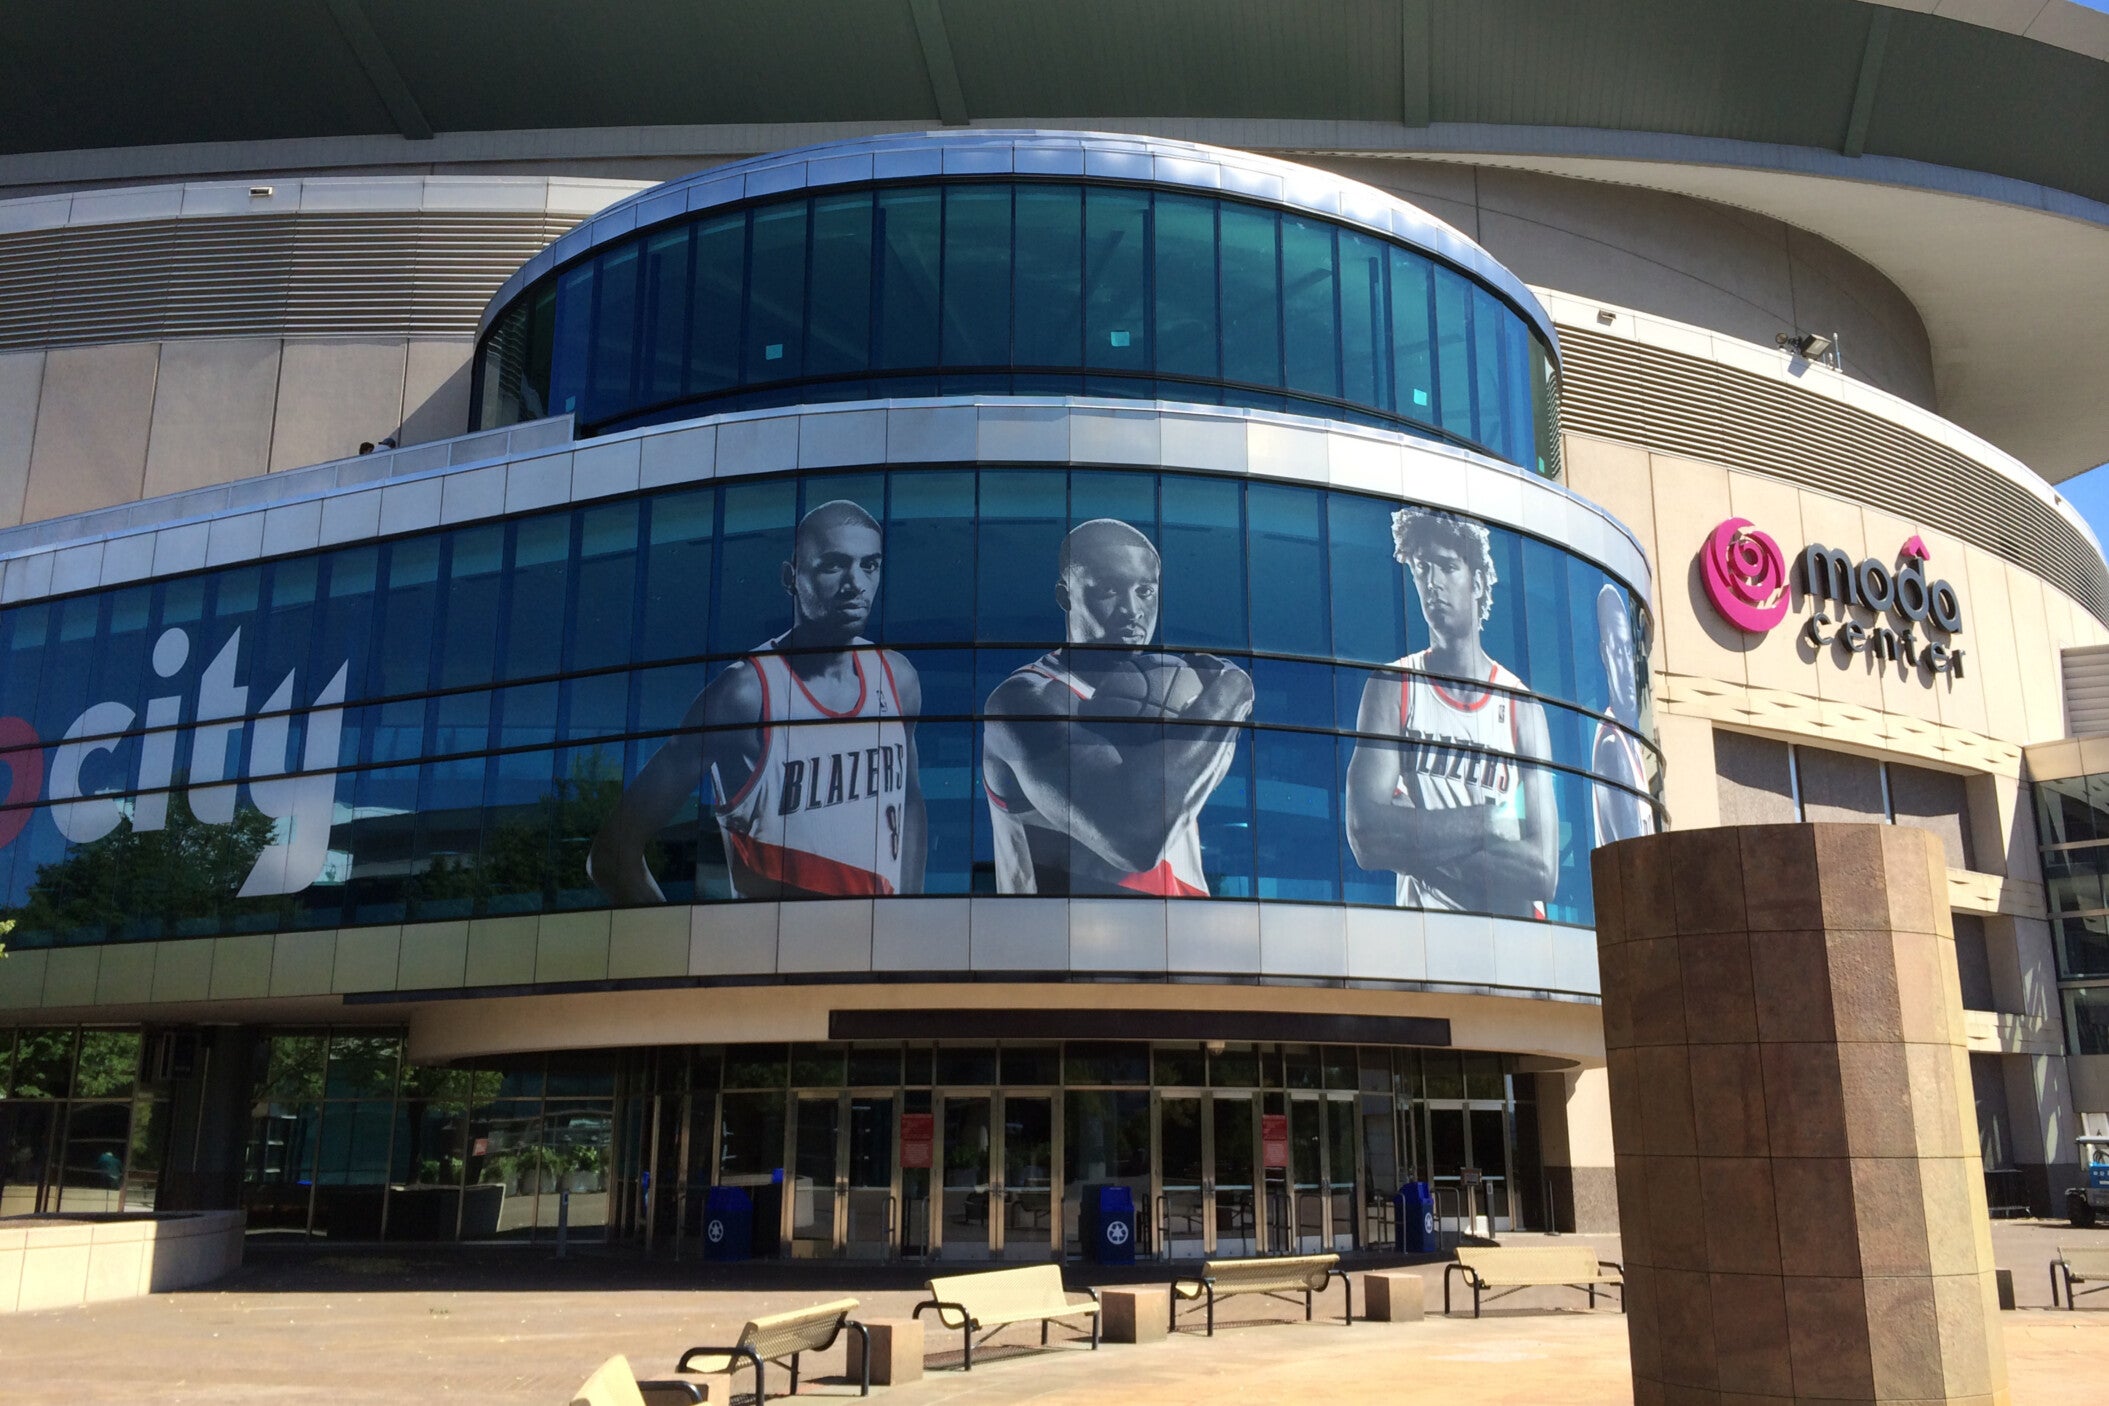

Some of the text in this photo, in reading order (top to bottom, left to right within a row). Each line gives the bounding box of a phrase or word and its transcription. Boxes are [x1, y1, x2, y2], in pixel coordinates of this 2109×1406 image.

[1802, 534, 1963, 634] moda
[1807, 612, 1966, 679] center
[778, 743, 904, 816] BLAZERS
